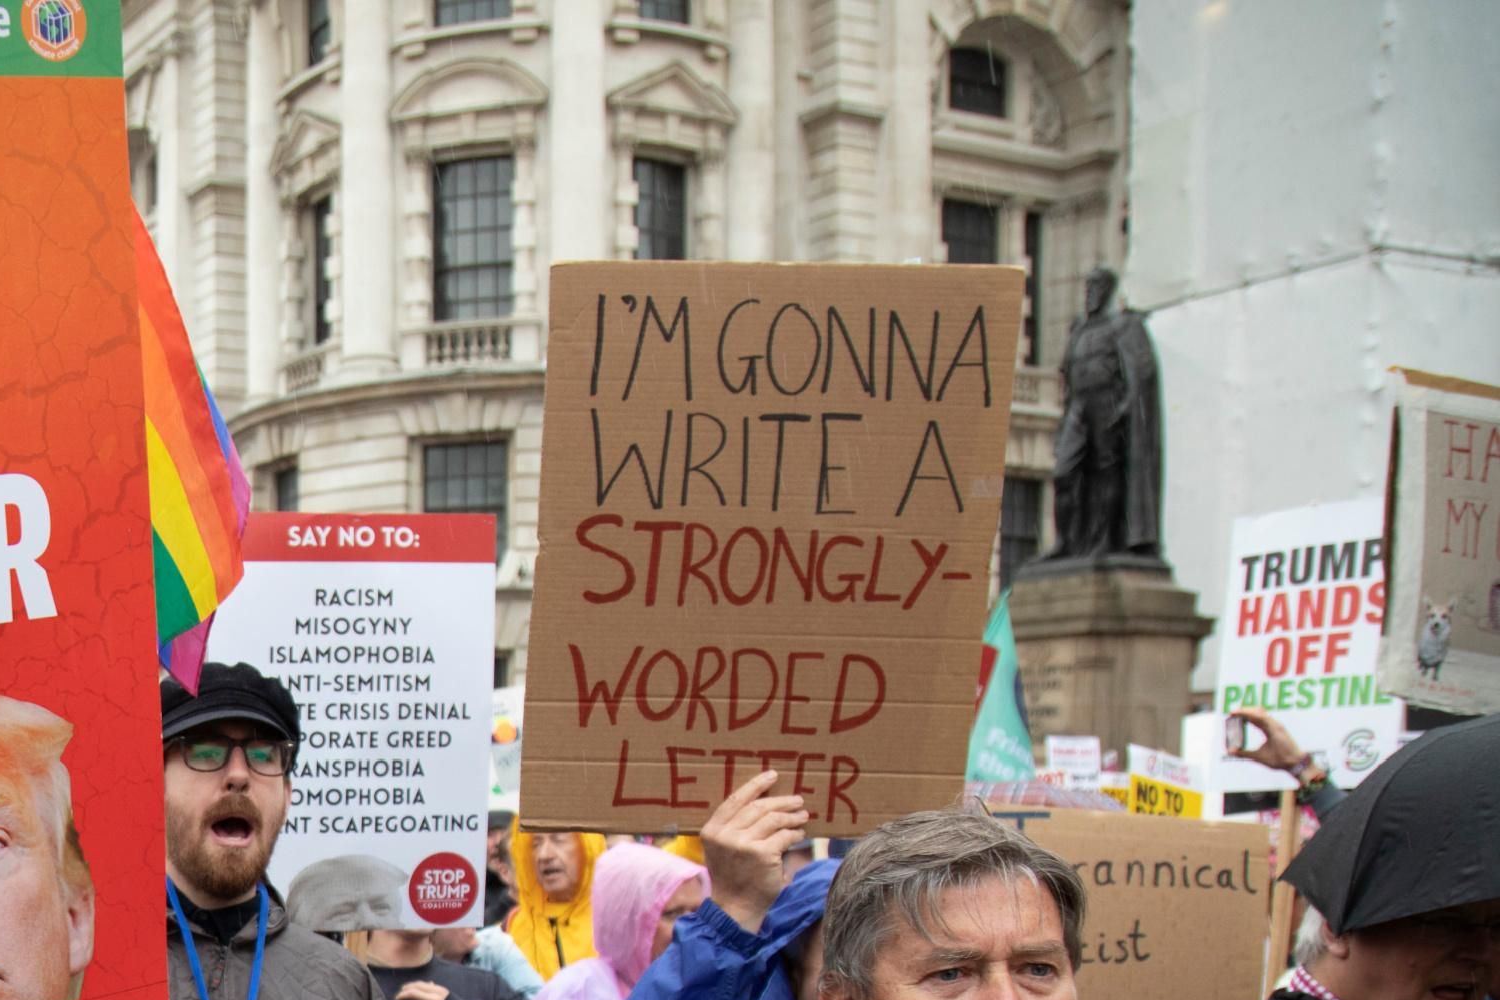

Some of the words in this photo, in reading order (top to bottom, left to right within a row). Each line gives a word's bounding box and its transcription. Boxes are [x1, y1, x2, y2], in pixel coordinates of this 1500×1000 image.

[589, 293, 693, 402] I'M
[716, 298, 992, 407] GONNA
[590, 407, 863, 516] WRITE
[894, 419, 964, 518] A
[287, 525, 329, 547] SAY
[337, 526, 376, 547] NO
[380, 526, 421, 548] TO:
[1442, 498, 1489, 560] MY
[575, 513, 972, 611] STRONGLY-
[1240, 537, 1384, 592] TRUMP
[314, 588, 394, 607] RACISM
[1237, 580, 1386, 638] HANDS
[294, 617, 413, 636] MISOGYNY
[269, 645, 436, 664] ISLAMOPHOBIA
[1265, 631, 1353, 679] OFF
[278, 674, 431, 693] NTI-SEMITISM
[568, 642, 887, 735] WORDED
[324, 702, 390, 721] CRISIS
[398, 702, 471, 721] DENIAL
[299, 731, 380, 749] PORATE
[386, 730, 452, 748] GREED
[290, 759, 425, 778] RANSPHOBIA
[612, 739, 861, 825] LETTER
[290, 787, 426, 806] OMOPHOBIA
[1136, 781, 1158, 807] NO
[1164, 788, 1184, 815] TO
[319, 814, 479, 834] SCAPEGOATING
[423, 868, 466, 885] STOP
[1072, 848, 1257, 895] rannical
[416, 883, 471, 900] TRUMP
[422, 901, 463, 910] COALITION
